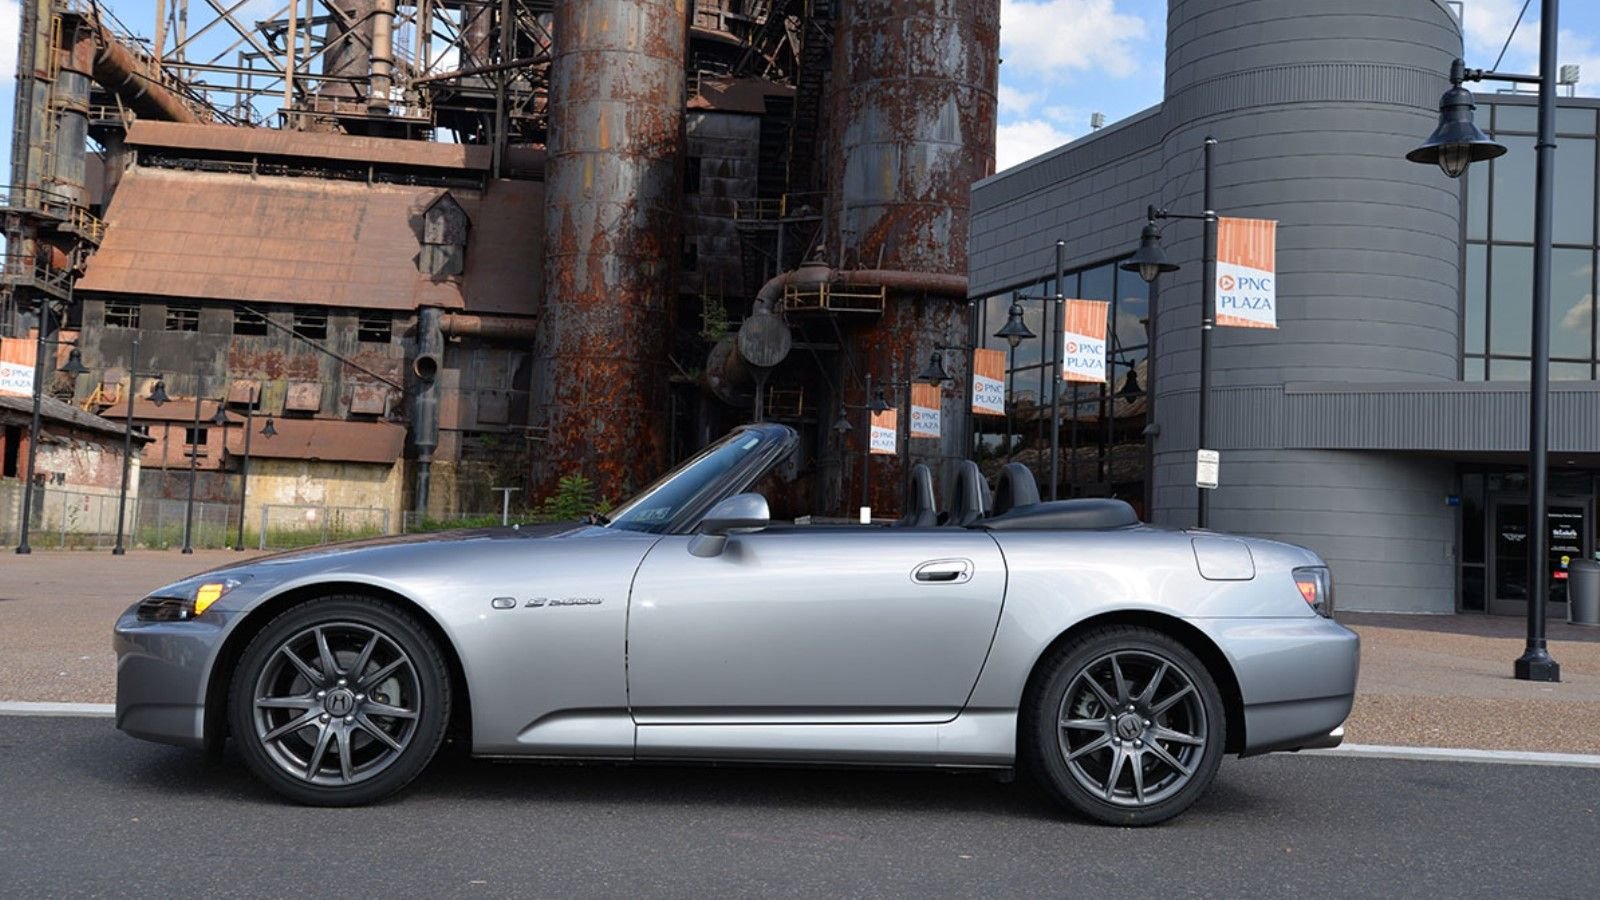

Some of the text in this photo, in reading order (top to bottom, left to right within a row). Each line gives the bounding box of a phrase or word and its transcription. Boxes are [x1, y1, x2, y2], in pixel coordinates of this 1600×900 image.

[1238, 276, 1271, 291] PNC
[1221, 295, 1272, 310] PLAZA
[1079, 343, 1103, 355] PNC
[1067, 357, 1103, 368] PLAZA
[12, 369, 32, 377] PNC
[2, 379, 31, 387] PLAZA
[984, 384, 1002, 393] PNC
[975, 394, 1002, 404] PLAZA
[921, 411, 938, 420] PNC
[913, 421, 938, 430] PLAZA
